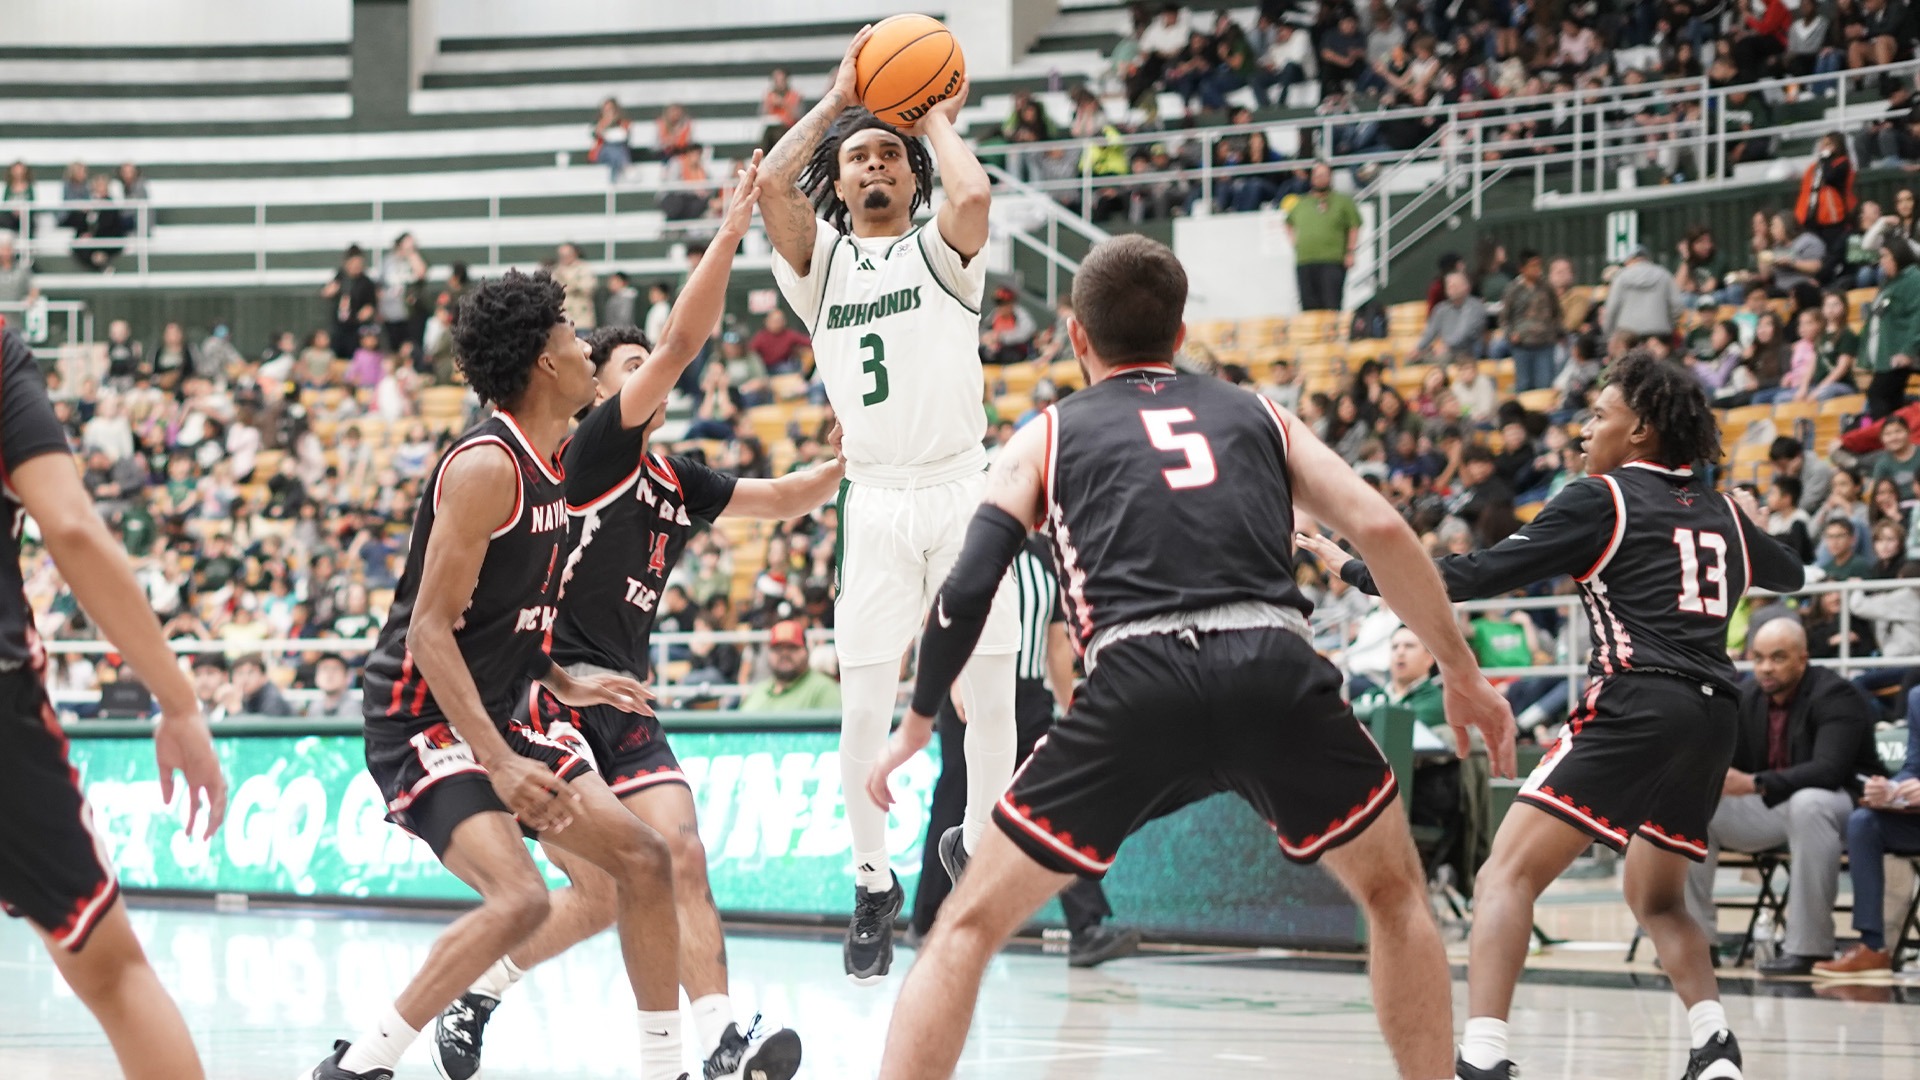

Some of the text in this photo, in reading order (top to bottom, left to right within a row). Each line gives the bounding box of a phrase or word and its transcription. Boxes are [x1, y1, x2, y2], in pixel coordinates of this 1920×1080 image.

[859, 333, 889, 407] 3
[1138, 407, 1218, 490] 5
[1672, 527, 1728, 618] 13
[224, 772, 328, 869] GO
